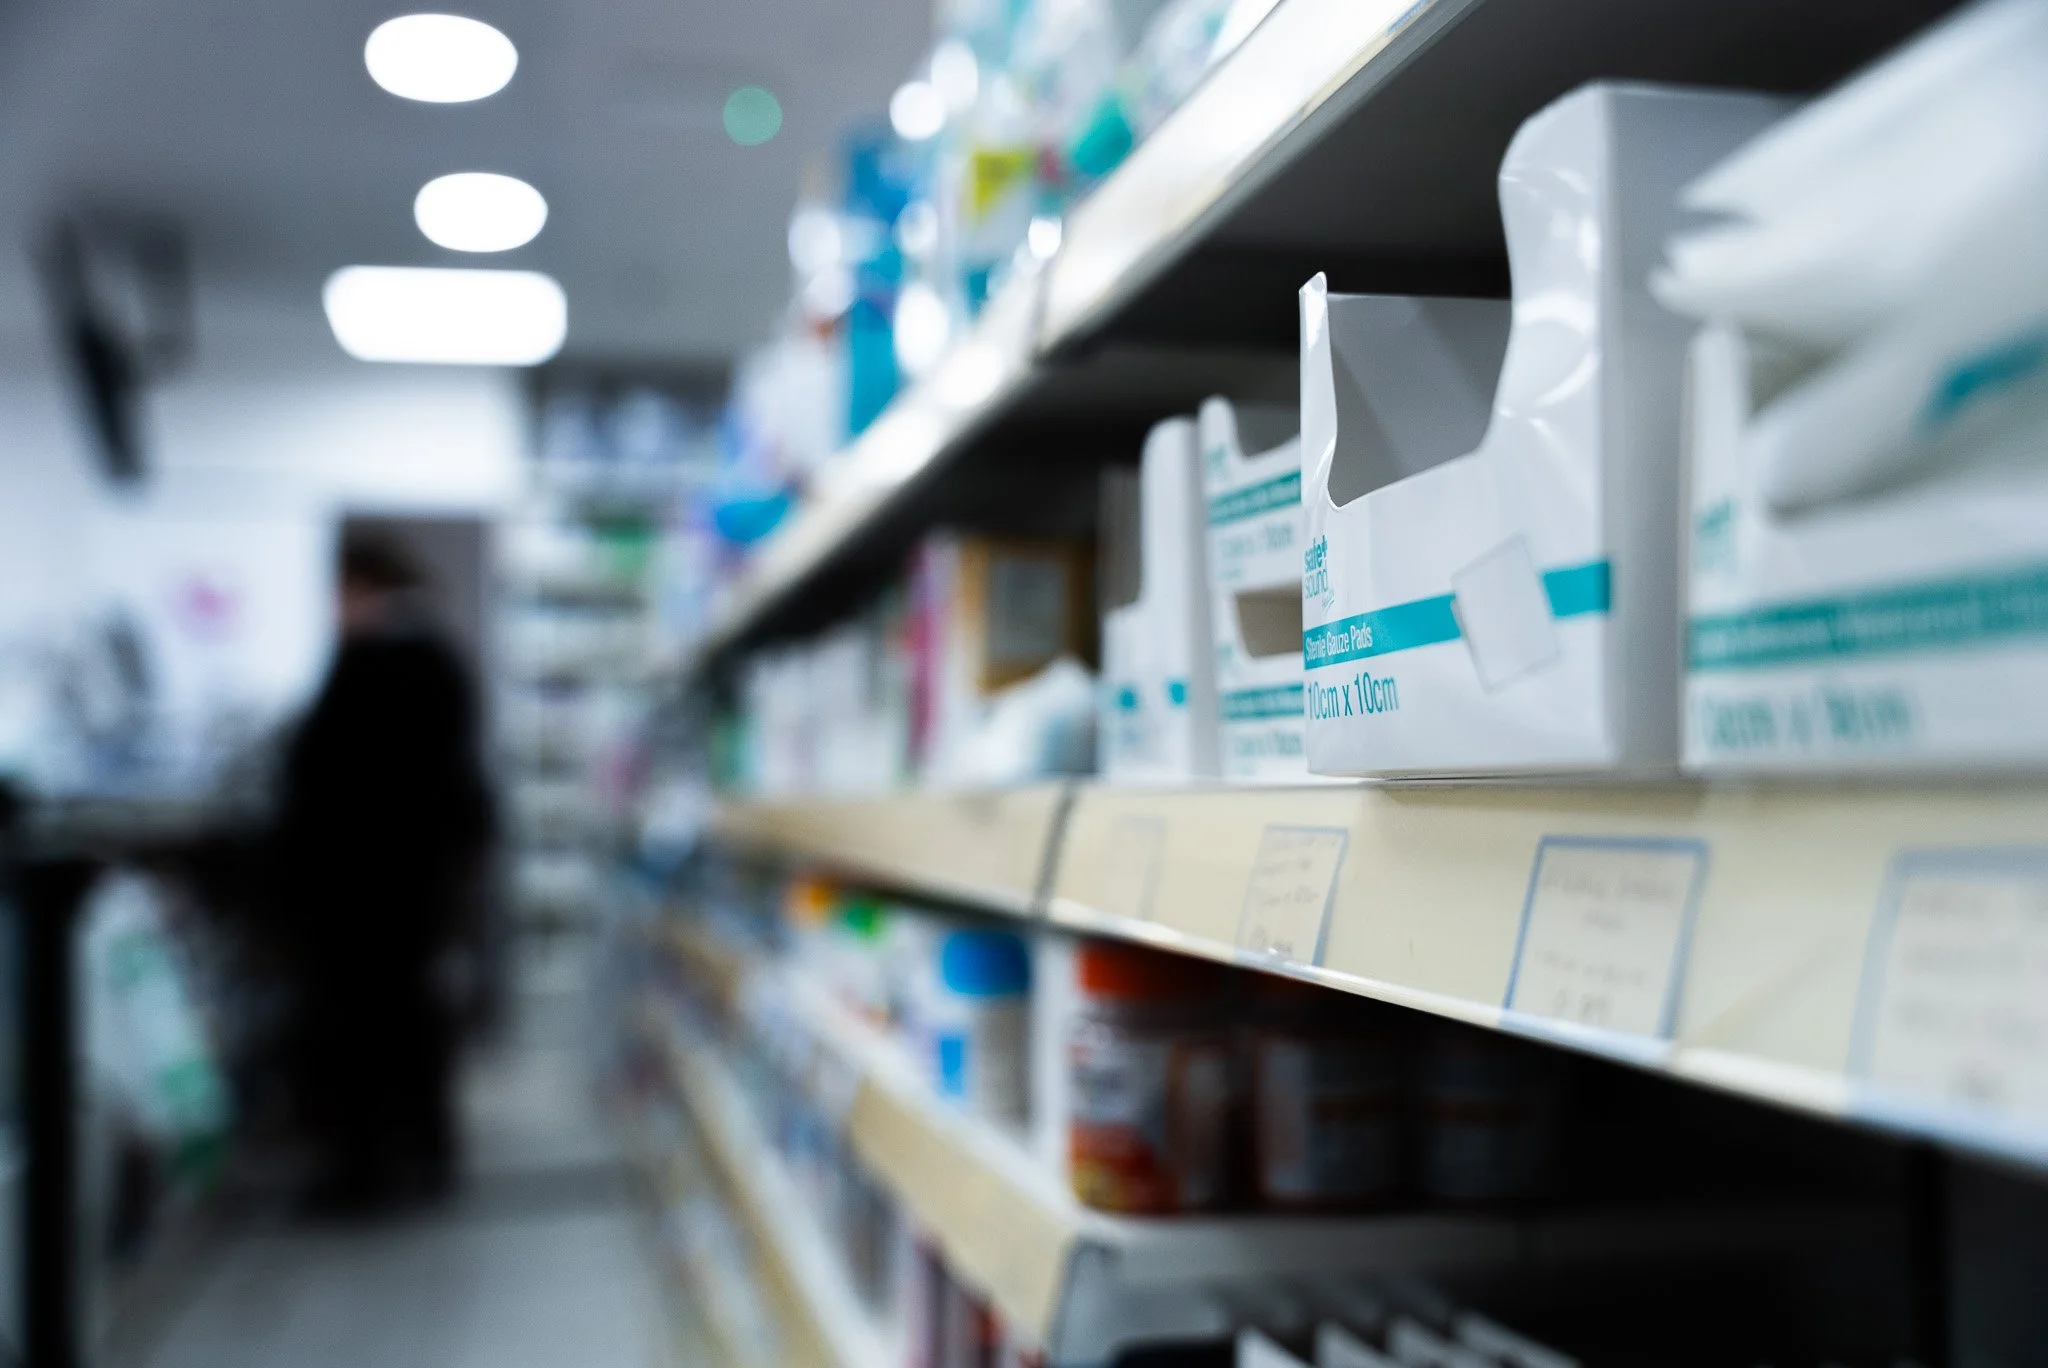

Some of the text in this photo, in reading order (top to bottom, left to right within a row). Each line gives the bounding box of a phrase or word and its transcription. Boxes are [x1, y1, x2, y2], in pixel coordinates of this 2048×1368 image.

[1304, 568, 1329, 600] sound
[1305, 622, 1373, 661] Sterile Gauze Pads
[1308, 680, 1340, 720] 10cm
[1342, 684, 1353, 717] x
[1354, 671, 1399, 714] 10cm
